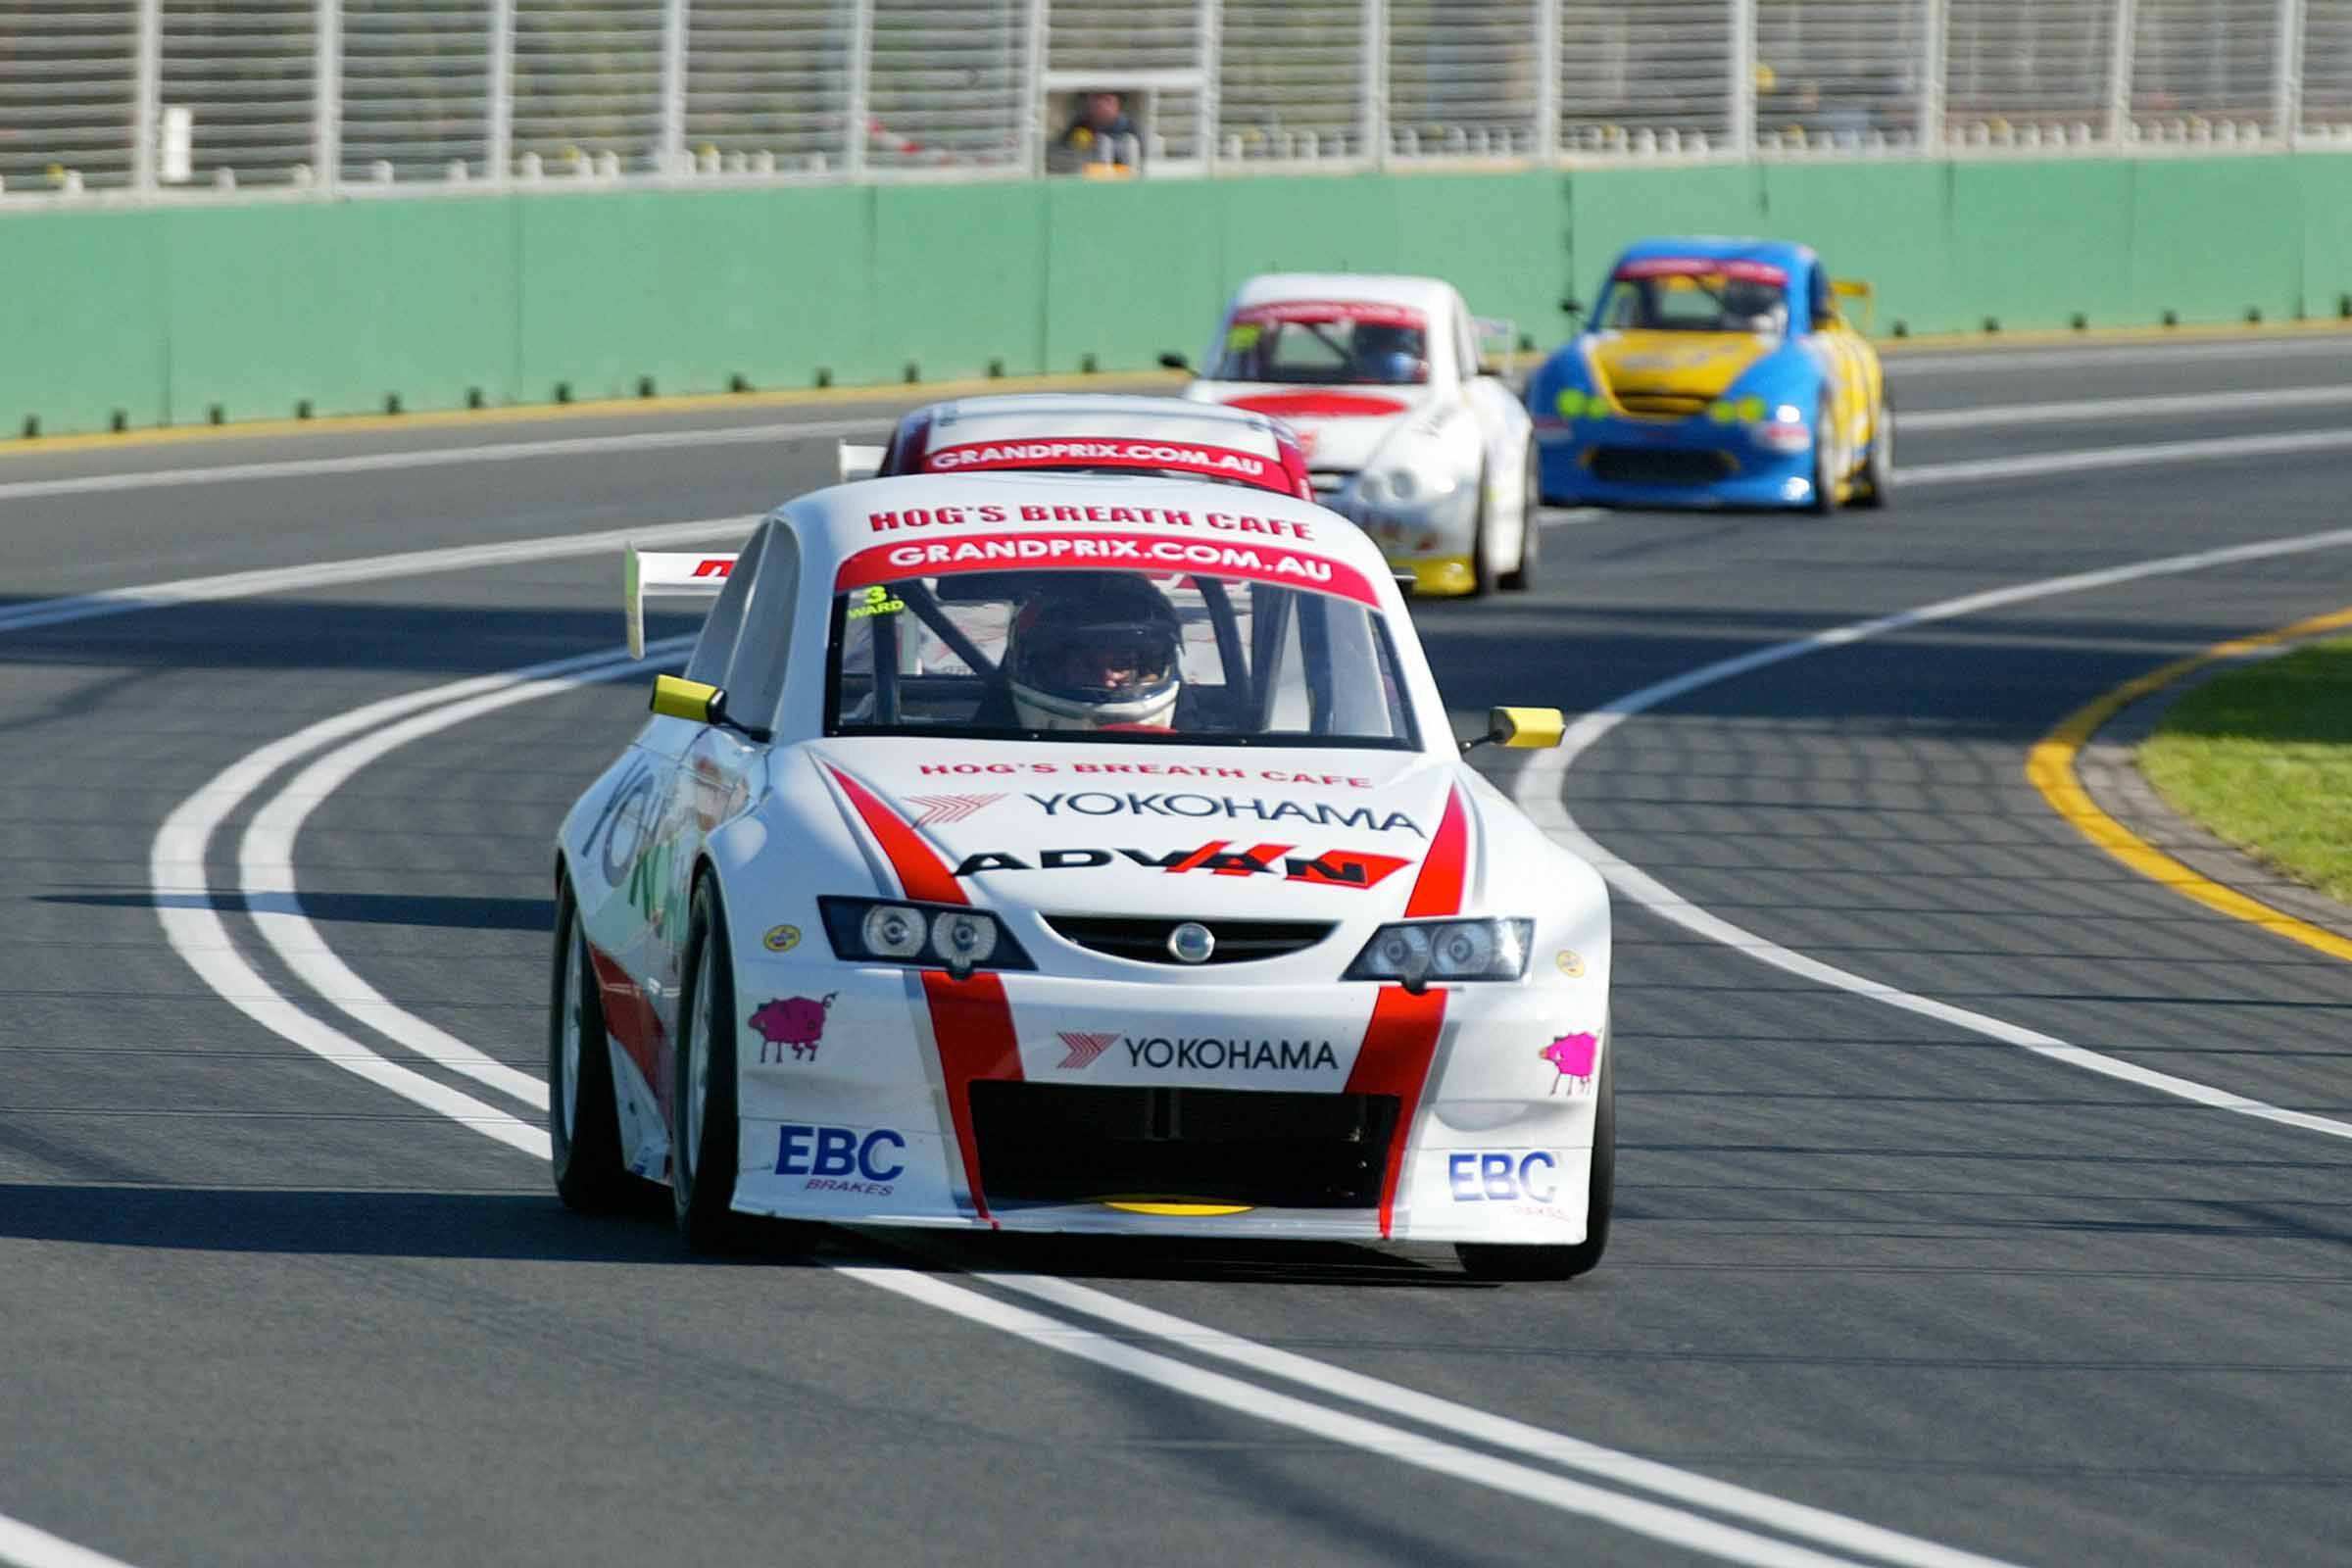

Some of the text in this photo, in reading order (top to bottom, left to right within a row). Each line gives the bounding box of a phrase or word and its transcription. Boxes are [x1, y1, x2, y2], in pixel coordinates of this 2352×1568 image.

[931, 443, 1264, 476] GRANDPRIX.COM.AU
[869, 505, 1316, 541] HOG'S BREATH CAFE
[888, 539, 1333, 581] GRANDPRIX.COM.AU
[848, 600, 905, 619] WARD
[864, 585, 887, 604] 3
[919, 762, 1374, 789] HOG'S BREATH CAFE
[1025, 792, 1427, 838] YOKOHAMA
[955, 841, 1417, 889] ADVAN
[1124, 1037, 1340, 1071] YOKOHAMA
[774, 1124, 906, 1182] EBC
[805, 1178, 895, 1197] BRAKES
[1447, 1150, 1557, 1204] EBC
